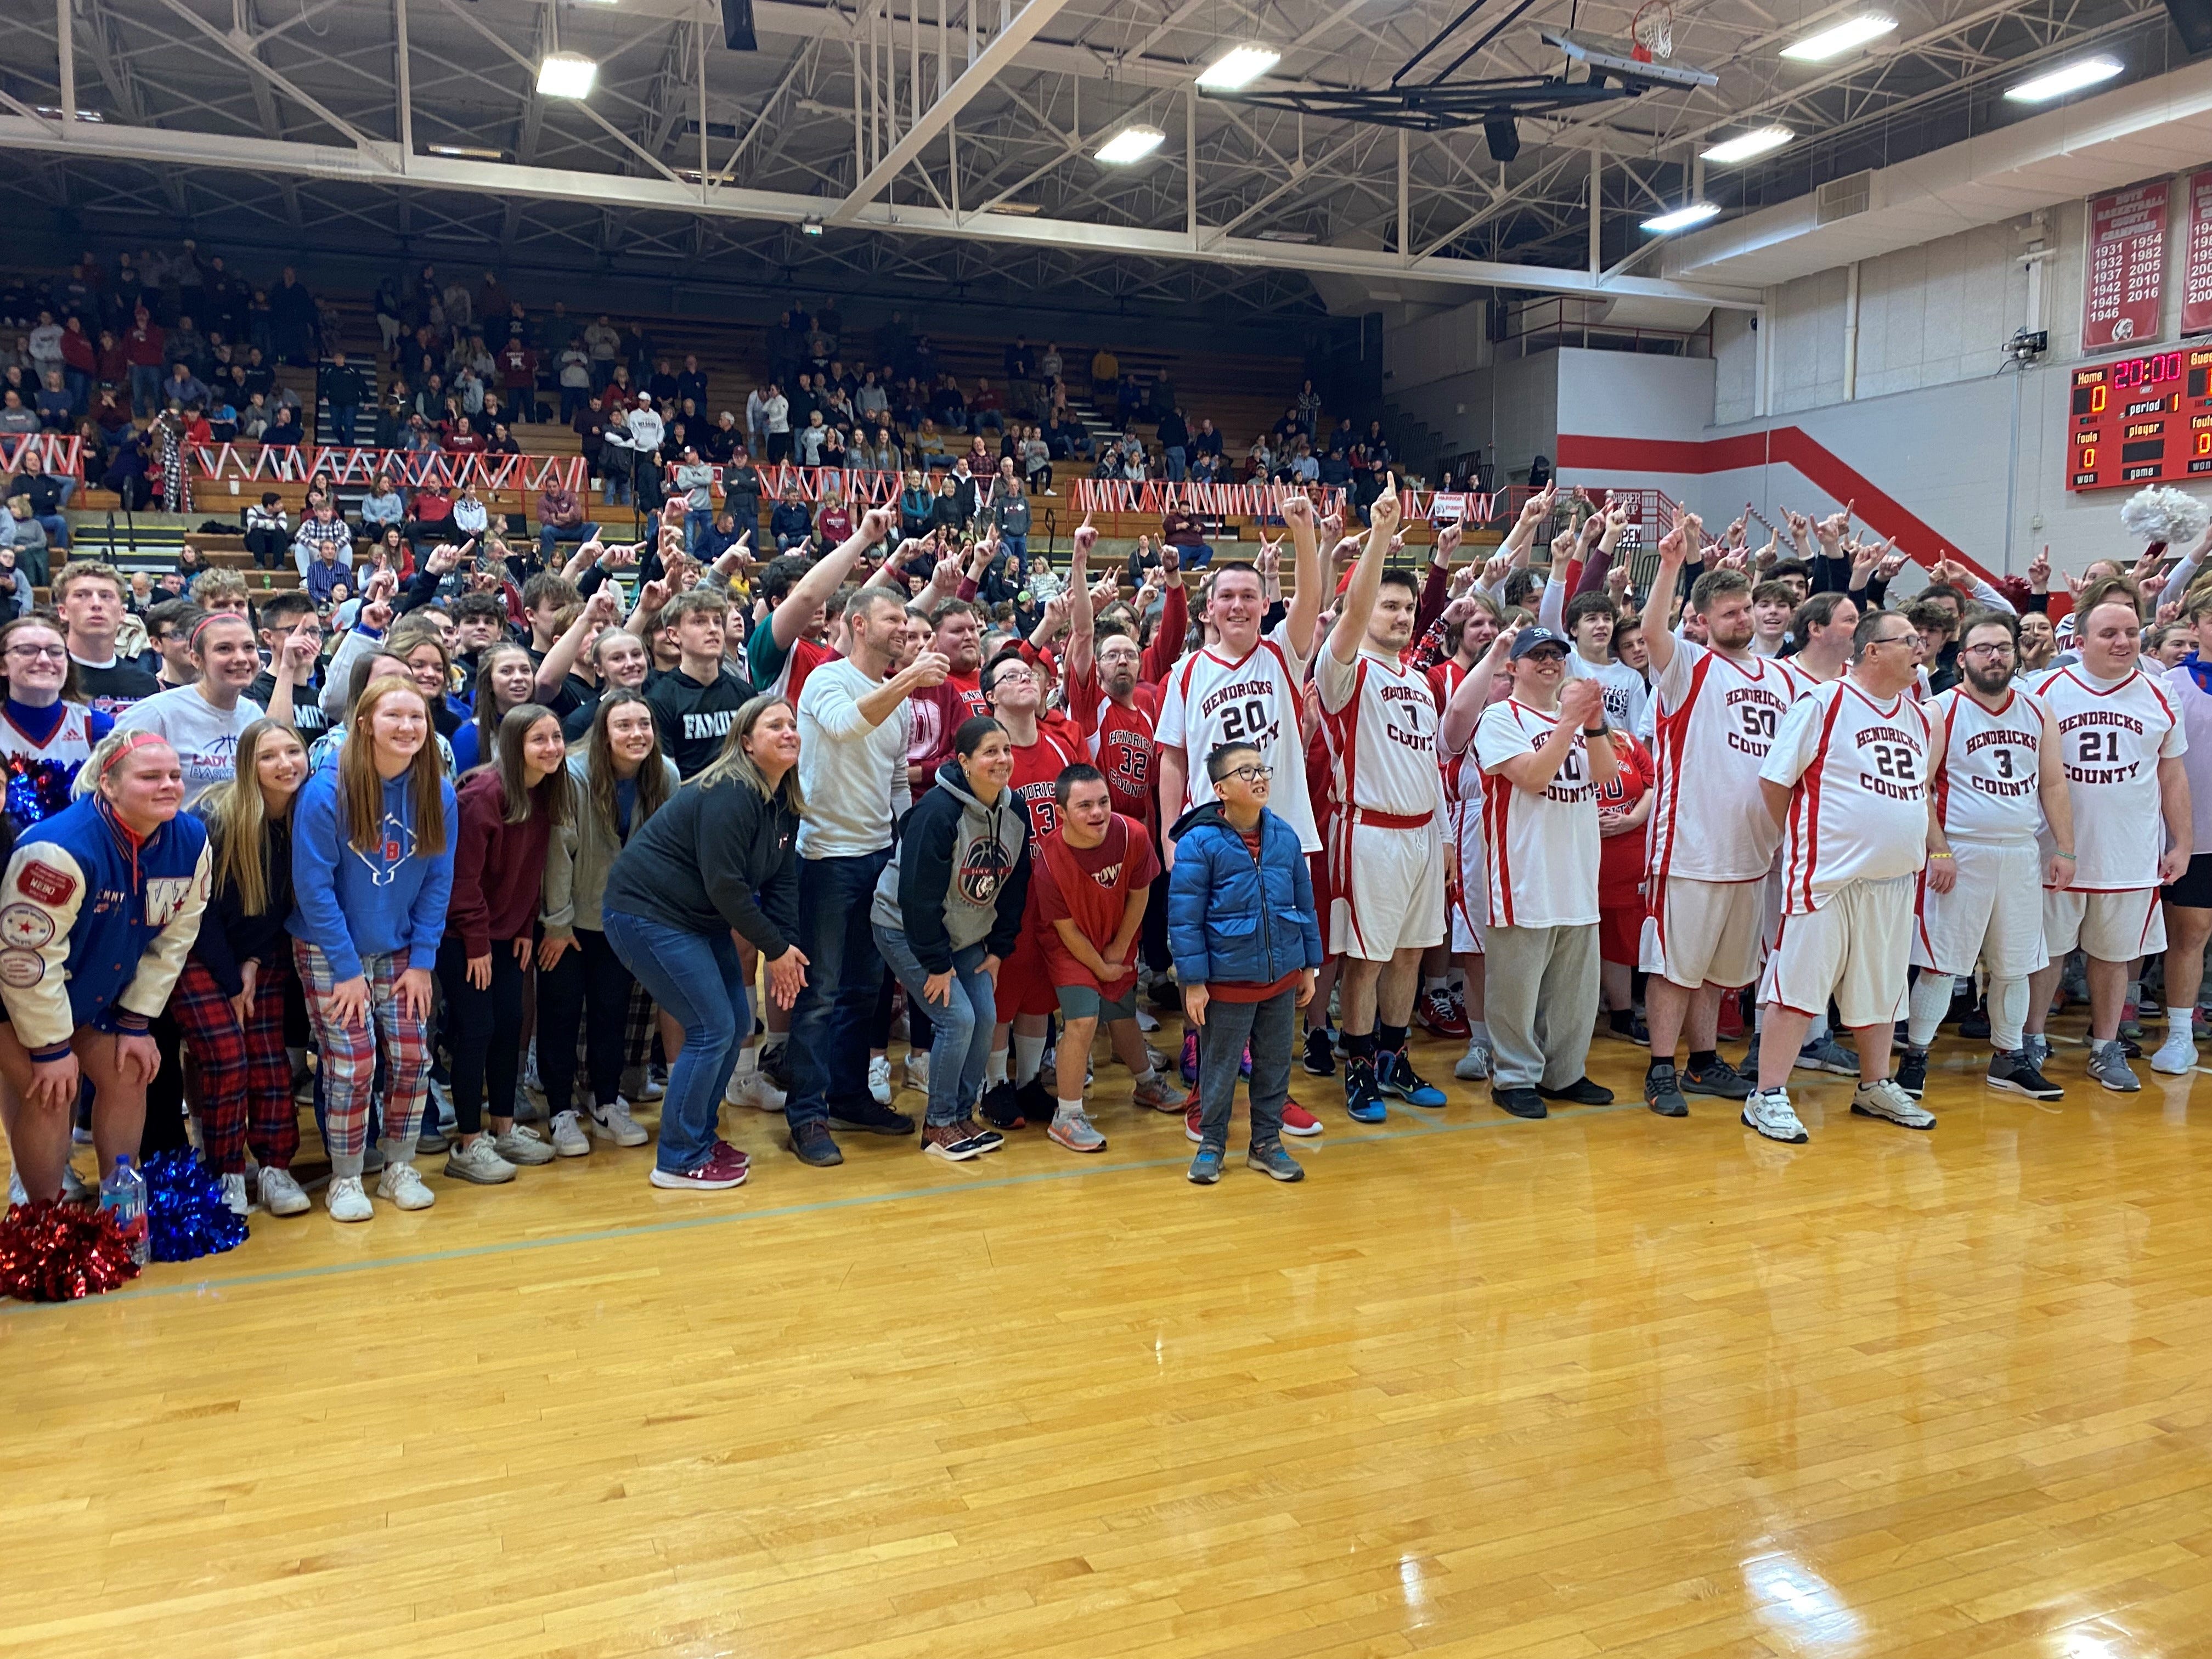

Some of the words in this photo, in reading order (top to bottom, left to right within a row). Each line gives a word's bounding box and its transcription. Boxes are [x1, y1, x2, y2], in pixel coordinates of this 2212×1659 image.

[2095, 242, 2123, 258] 1931
[2131, 233, 2163, 249] 1954
[2094, 255, 2123, 270] 1932
[2131, 246, 2162, 262] 1982
[2094, 268, 2122, 284] 1937
[2129, 260, 2160, 276] 2005
[2191, 262, 2212, 276] 200
[2093, 281, 2121, 297] 1942
[2128, 273, 2159, 290] 2010
[2189, 276, 2212, 291] 200
[2091, 294, 2120, 309] 1945
[2128, 287, 2158, 302] 2016
[2188, 289, 2212, 303] 200
[2090, 307, 2119, 323] 1946
[2078, 371, 2102, 385] Home
[2115, 352, 2181, 390] 20:00
[2091, 385, 2106, 413] 0
[2130, 399, 2160, 416] period
[2173, 393, 2179, 411] 1
[2077, 432, 2097, 444] fouls
[2129, 422, 2160, 438] player
[2199, 432, 2211, 454] 0
[2084, 448, 2095, 467] 0
[2193, 460, 2211, 471] won
[2077, 473, 2094, 484] won
[2130, 467, 2153, 480] game
[1617, 529, 1641, 544] PEN
[1202, 680, 1273, 720] HENDRICKS
[293, 704, 329, 730] MILY
[1220, 700, 1267, 741] 20
[1742, 706, 1775, 740] 50
[2058, 711, 2143, 736] HENDRICKS
[1109, 730, 1152, 756] HENDRIC
[1387, 724, 1435, 751] COUNT
[1728, 732, 1771, 758] COUN
[1855, 727, 1922, 757] HENDRICKS
[1966, 730, 2036, 755] HENDRICKS
[2079, 732, 2119, 761] 21
[193, 754, 227, 768] LADY
[1120, 746, 1148, 781] 32
[1874, 745, 1915, 780] 22
[1994, 749, 2013, 778] 3
[190, 764, 235, 782] BASKE
[2063, 760, 2140, 784] COUNTY
[1015, 782, 1056, 801] NDRIC
[1539, 782, 1594, 803] OUNT
[1860, 772, 1925, 801] COUNTY
[1972, 772, 2036, 796] COUNTY
[30, 877, 55, 895] NEBO
[126, 1199, 144, 1219] FIJI
